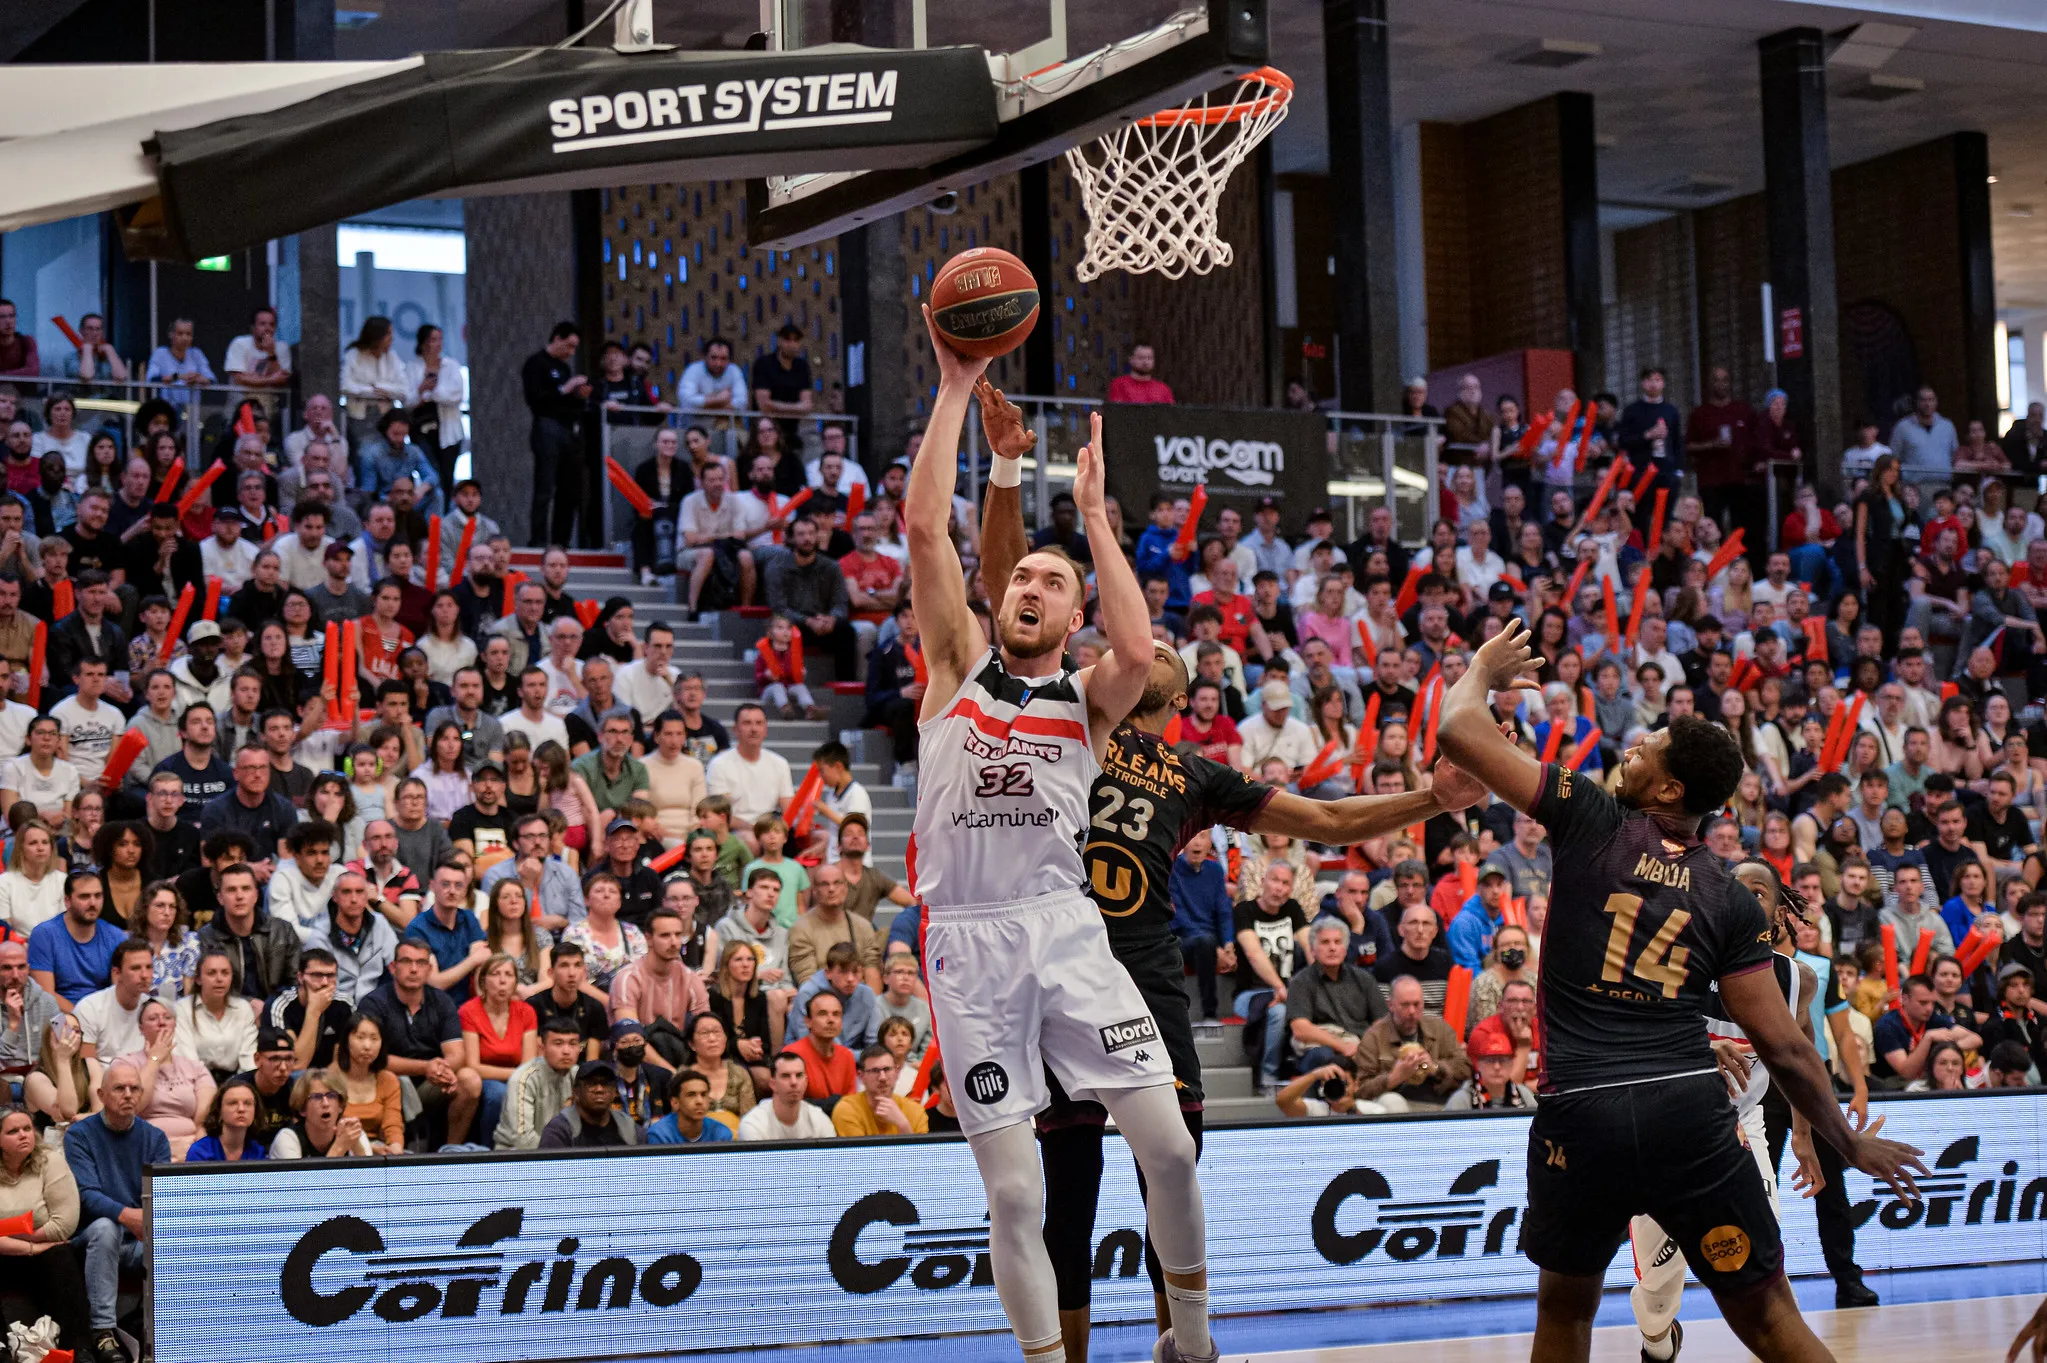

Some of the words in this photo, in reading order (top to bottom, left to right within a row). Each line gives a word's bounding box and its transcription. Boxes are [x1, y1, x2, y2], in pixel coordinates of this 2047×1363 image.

[548, 84, 707, 139] SPORT
[712, 69, 899, 132] SYSTEM
[975, 762, 1034, 798] 32
[1107, 738, 1187, 795] RLÉANS
[1091, 785, 1155, 841] 23
[1091, 858, 1132, 901] U
[1601, 892, 1692, 1000] 14
[1103, 1017, 1154, 1047] Nord
[1545, 1139, 1567, 1170] 14
[1704, 1233, 1744, 1253] SPORT
